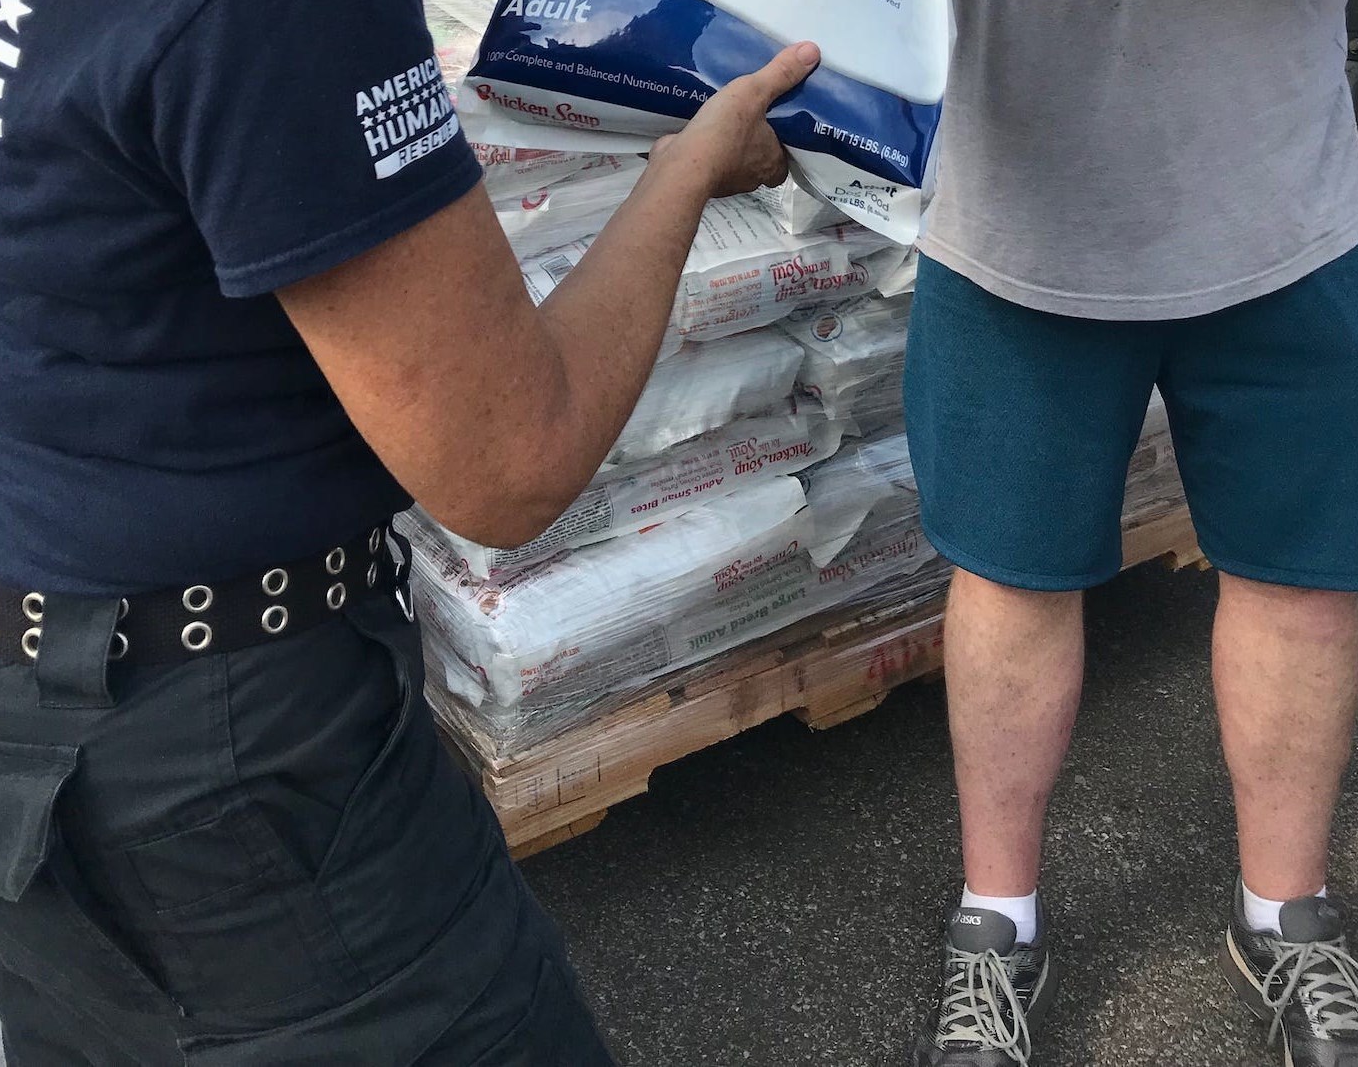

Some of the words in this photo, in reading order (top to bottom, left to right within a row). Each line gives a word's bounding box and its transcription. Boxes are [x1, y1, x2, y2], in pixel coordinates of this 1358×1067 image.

[356, 55, 442, 116] AMERIC
[504, 47, 554, 69] Complete
[555, 59, 574, 73] and
[577, 63, 621, 84] Balanced
[622, 73, 670, 95] Nutrition
[672, 84, 688, 98] for
[364, 89, 454, 157] HUMAN
[476, 84, 548, 117] Chicken
[551, 102, 600, 128] Soup
[813, 121, 834, 136] NET
[833, 127, 848, 142] WT
[848, 134, 860, 147] 15
[860, 137, 880, 155] LBS.
[880, 144, 909, 168] (6.8kg)
[865, 190, 890, 212] Food
[771, 254, 804, 286] Soul
[735, 454, 773, 476] Soup
[694, 477, 724, 493] Adult
[630, 499, 659, 514] Bites
